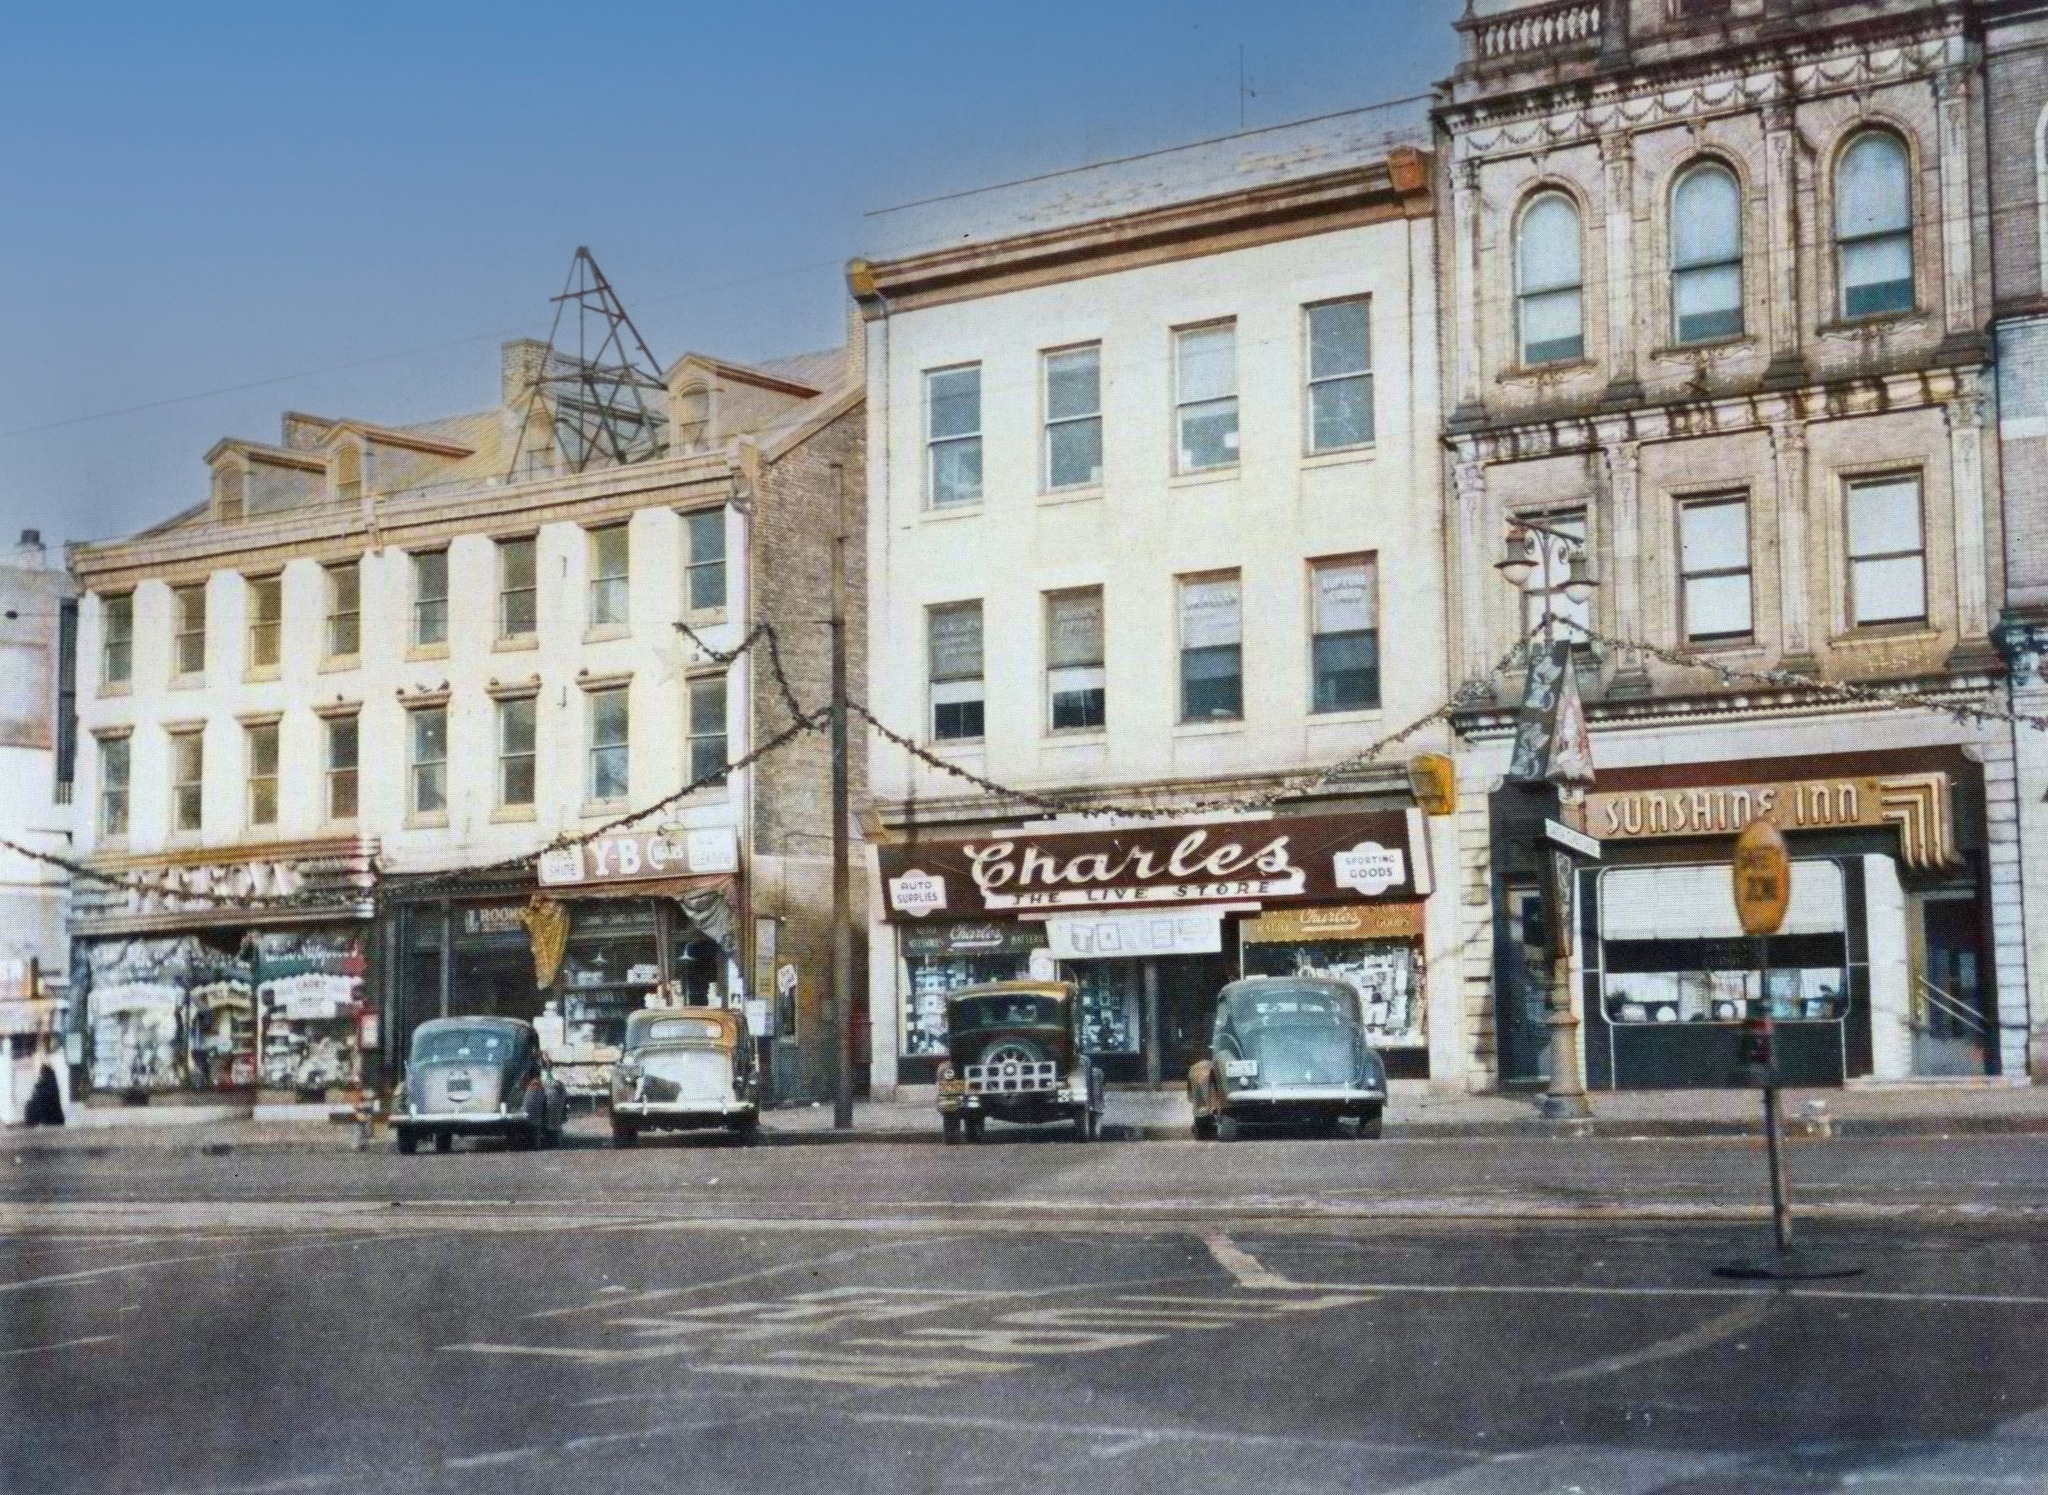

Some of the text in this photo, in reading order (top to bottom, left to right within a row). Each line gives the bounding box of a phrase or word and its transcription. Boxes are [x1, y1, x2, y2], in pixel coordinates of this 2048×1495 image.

[1605, 781, 1860, 836] SUNSHINE INN
[963, 829, 1292, 888] Charles
[1345, 854, 1396, 866] SPORTING
[1349, 867, 1394, 879] GOODS
[901, 880, 932, 891] AUTO
[896, 892, 938, 905] SUPPLIES
[1013, 881, 1272, 905] THE LIVE STORE
